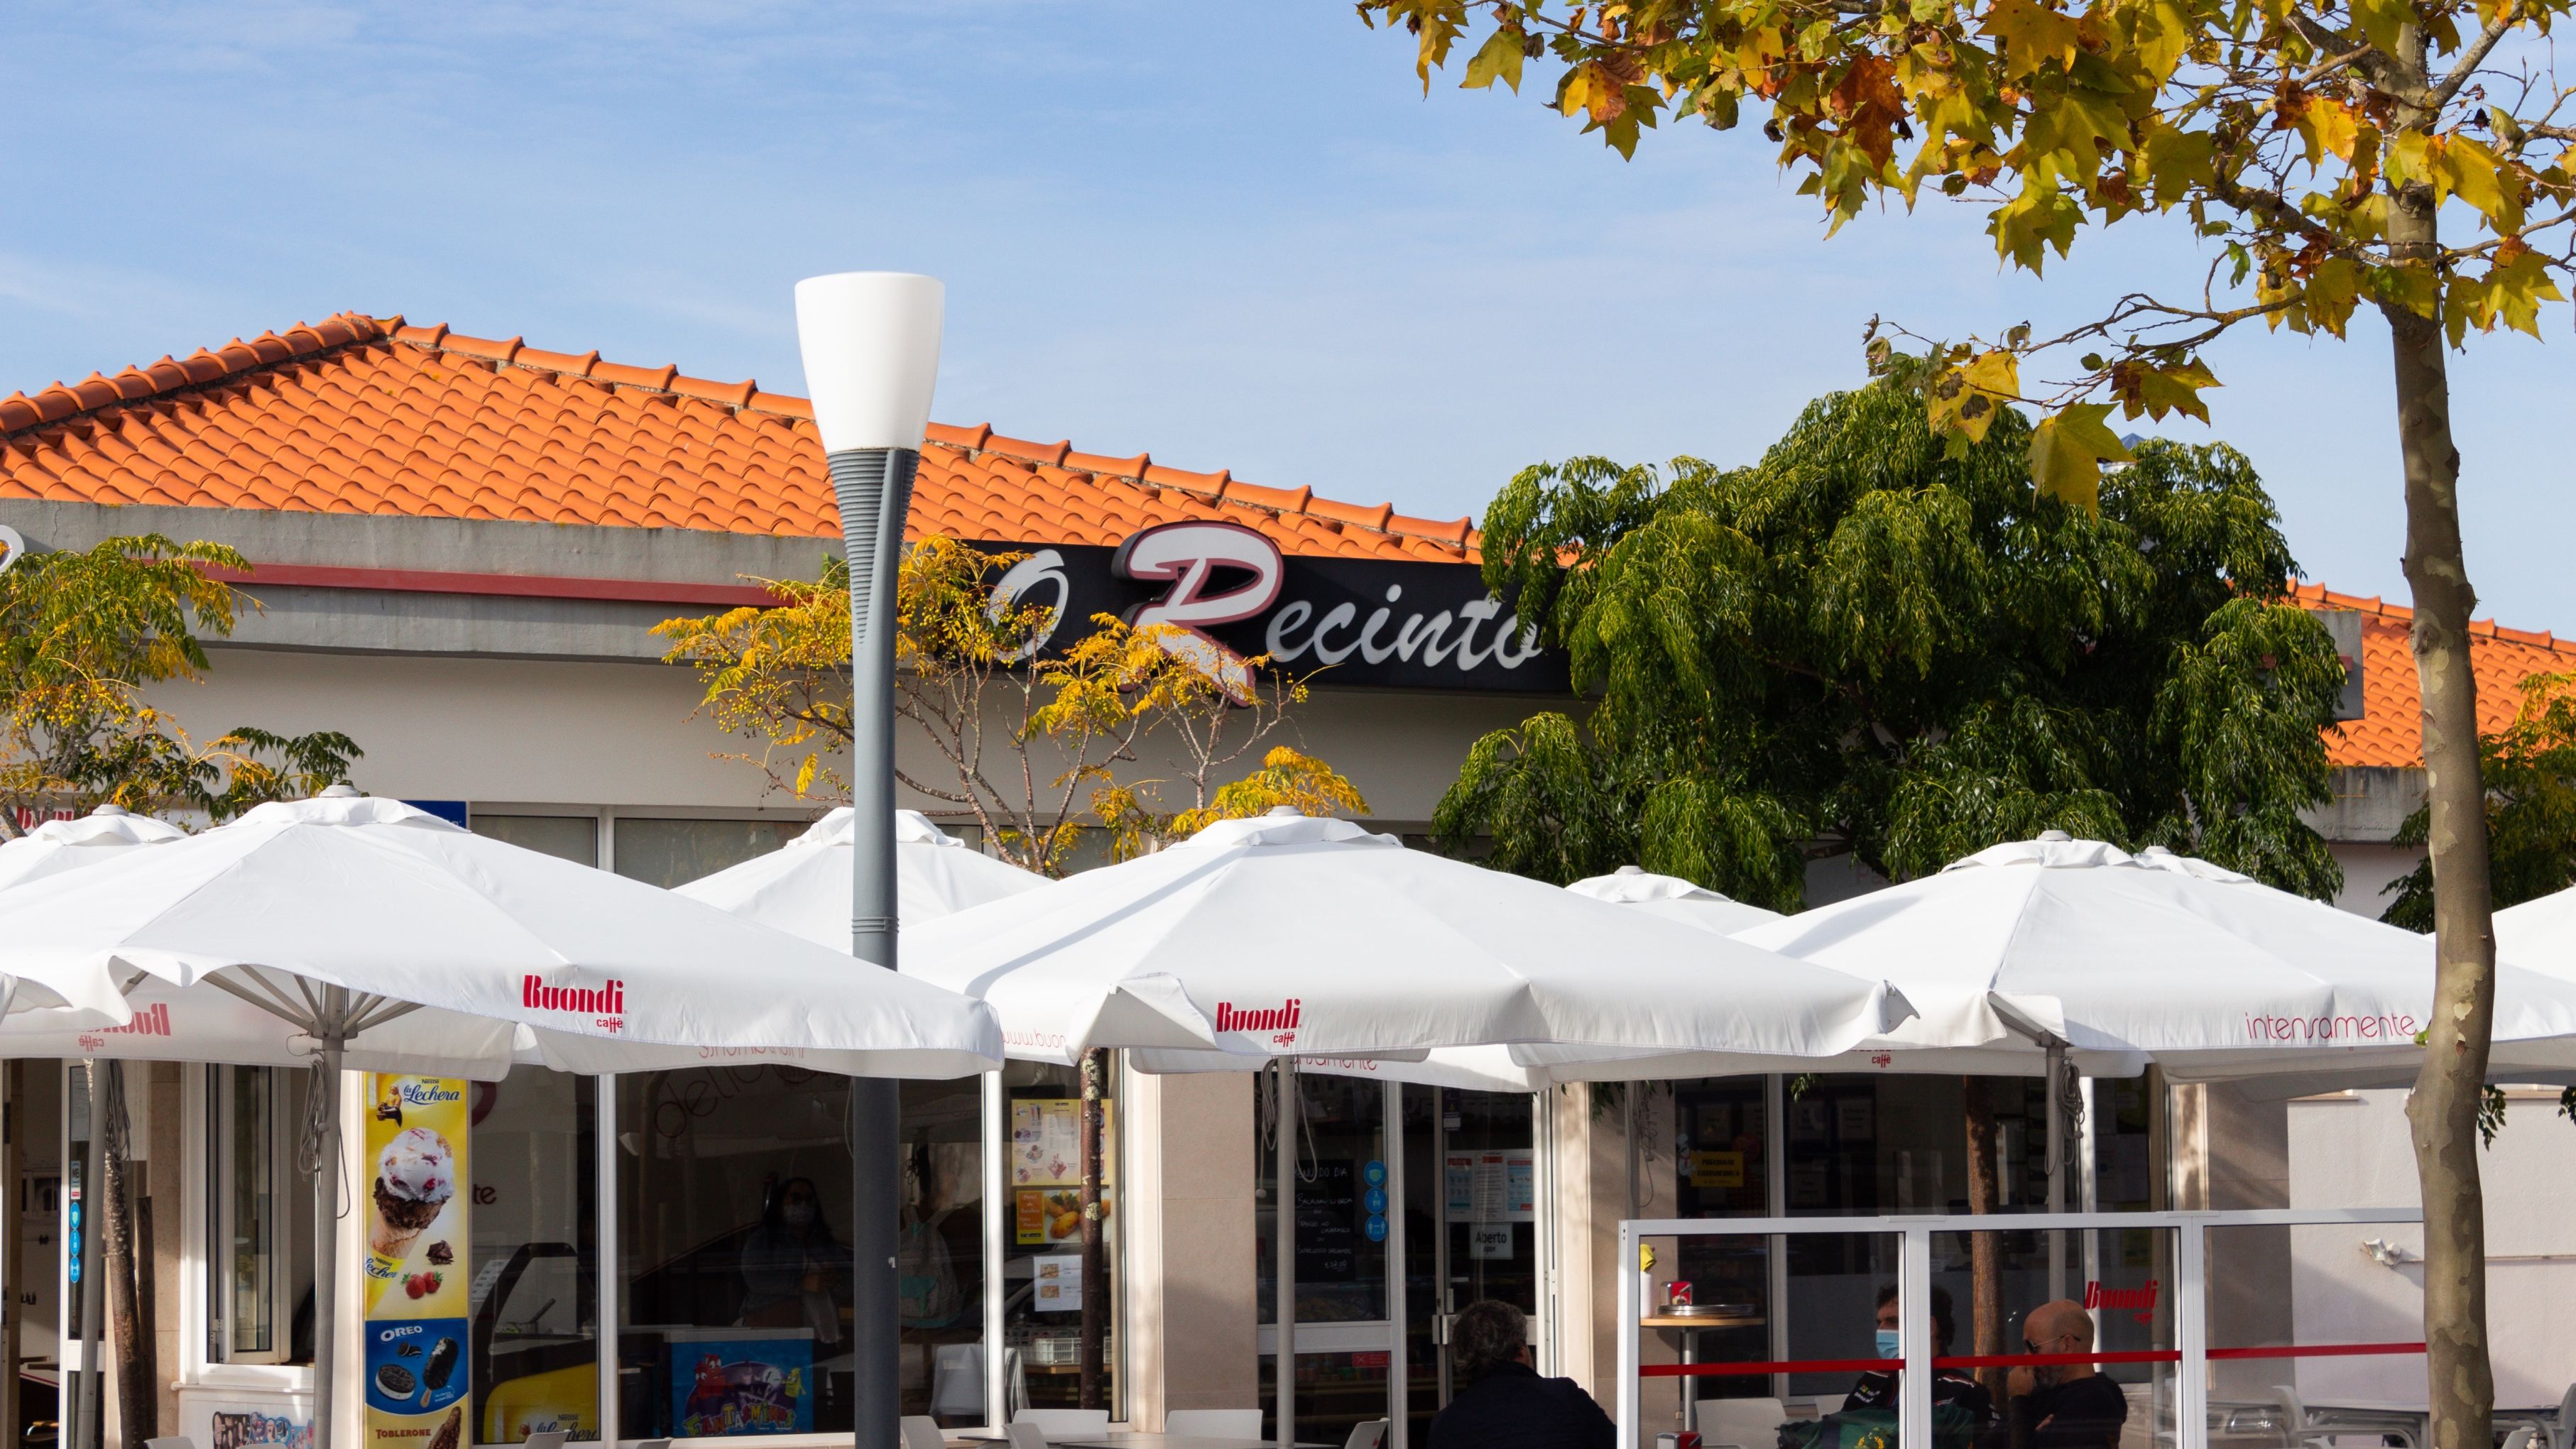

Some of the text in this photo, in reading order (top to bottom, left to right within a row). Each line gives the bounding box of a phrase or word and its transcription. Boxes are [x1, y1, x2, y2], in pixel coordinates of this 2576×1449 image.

[983, 519, 1542, 709] O Recinto
[523, 975, 623, 1014] Buondi
[1216, 999, 1300, 1032] Buondi
[596, 1017, 623, 1033] caffè
[2245, 1012, 2417, 1039] intensamente
[1273, 1032, 1295, 1048] caffè
[1872, 1054, 1892, 1068] caffè
[404, 1085, 460, 1105] Lechera
[1475, 1231, 1507, 1244] Aberto
[2084, 1279, 2159, 1310] Buondi
[381, 1325, 423, 1342] OREO
[376, 1429, 432, 1440] TOBLERONE
